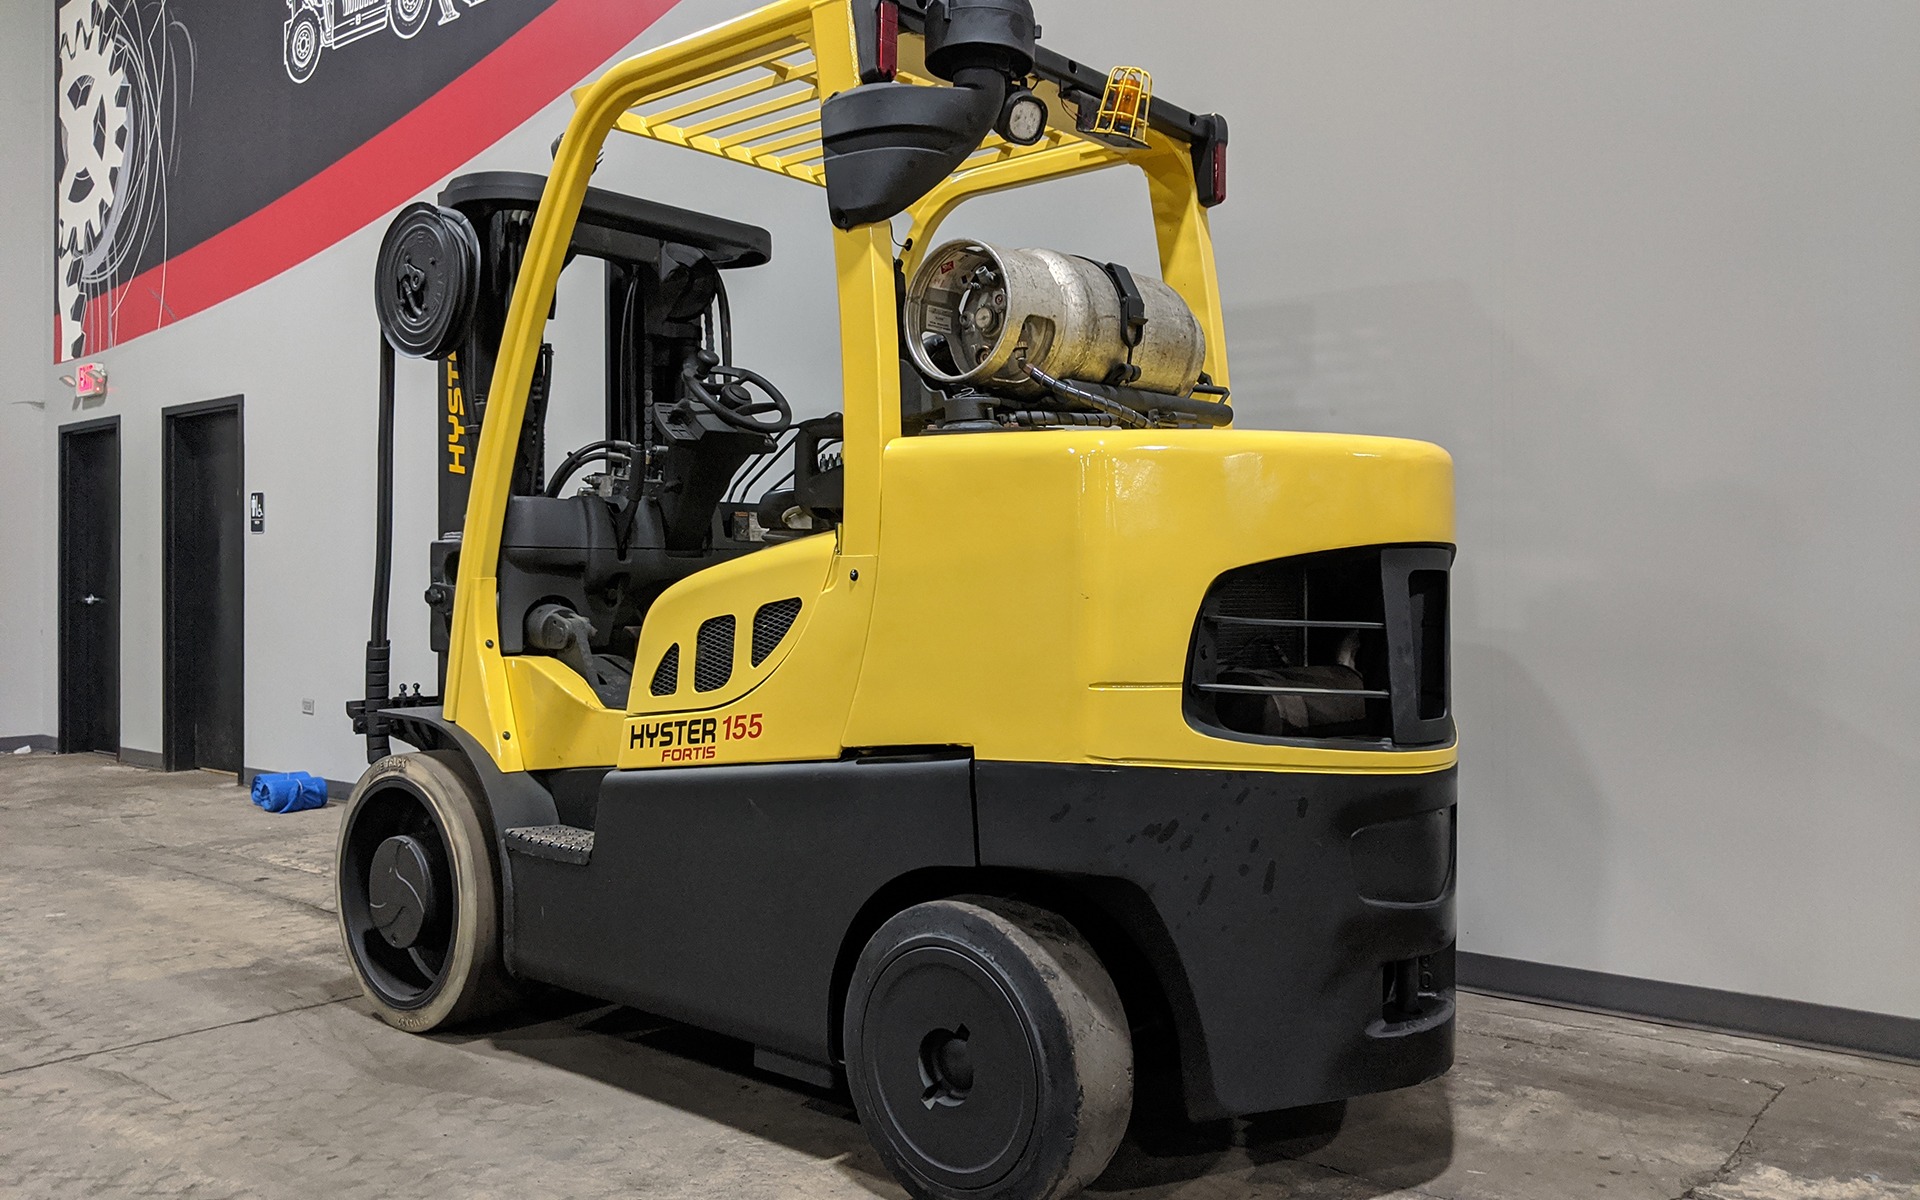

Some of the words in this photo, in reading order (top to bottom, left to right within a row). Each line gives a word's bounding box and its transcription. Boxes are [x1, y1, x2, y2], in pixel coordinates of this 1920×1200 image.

[447, 351, 465, 474] HYST
[629, 717, 717, 750] HYSTER
[722, 713, 763, 740] 155
[661, 745, 716, 762] FORTIS
